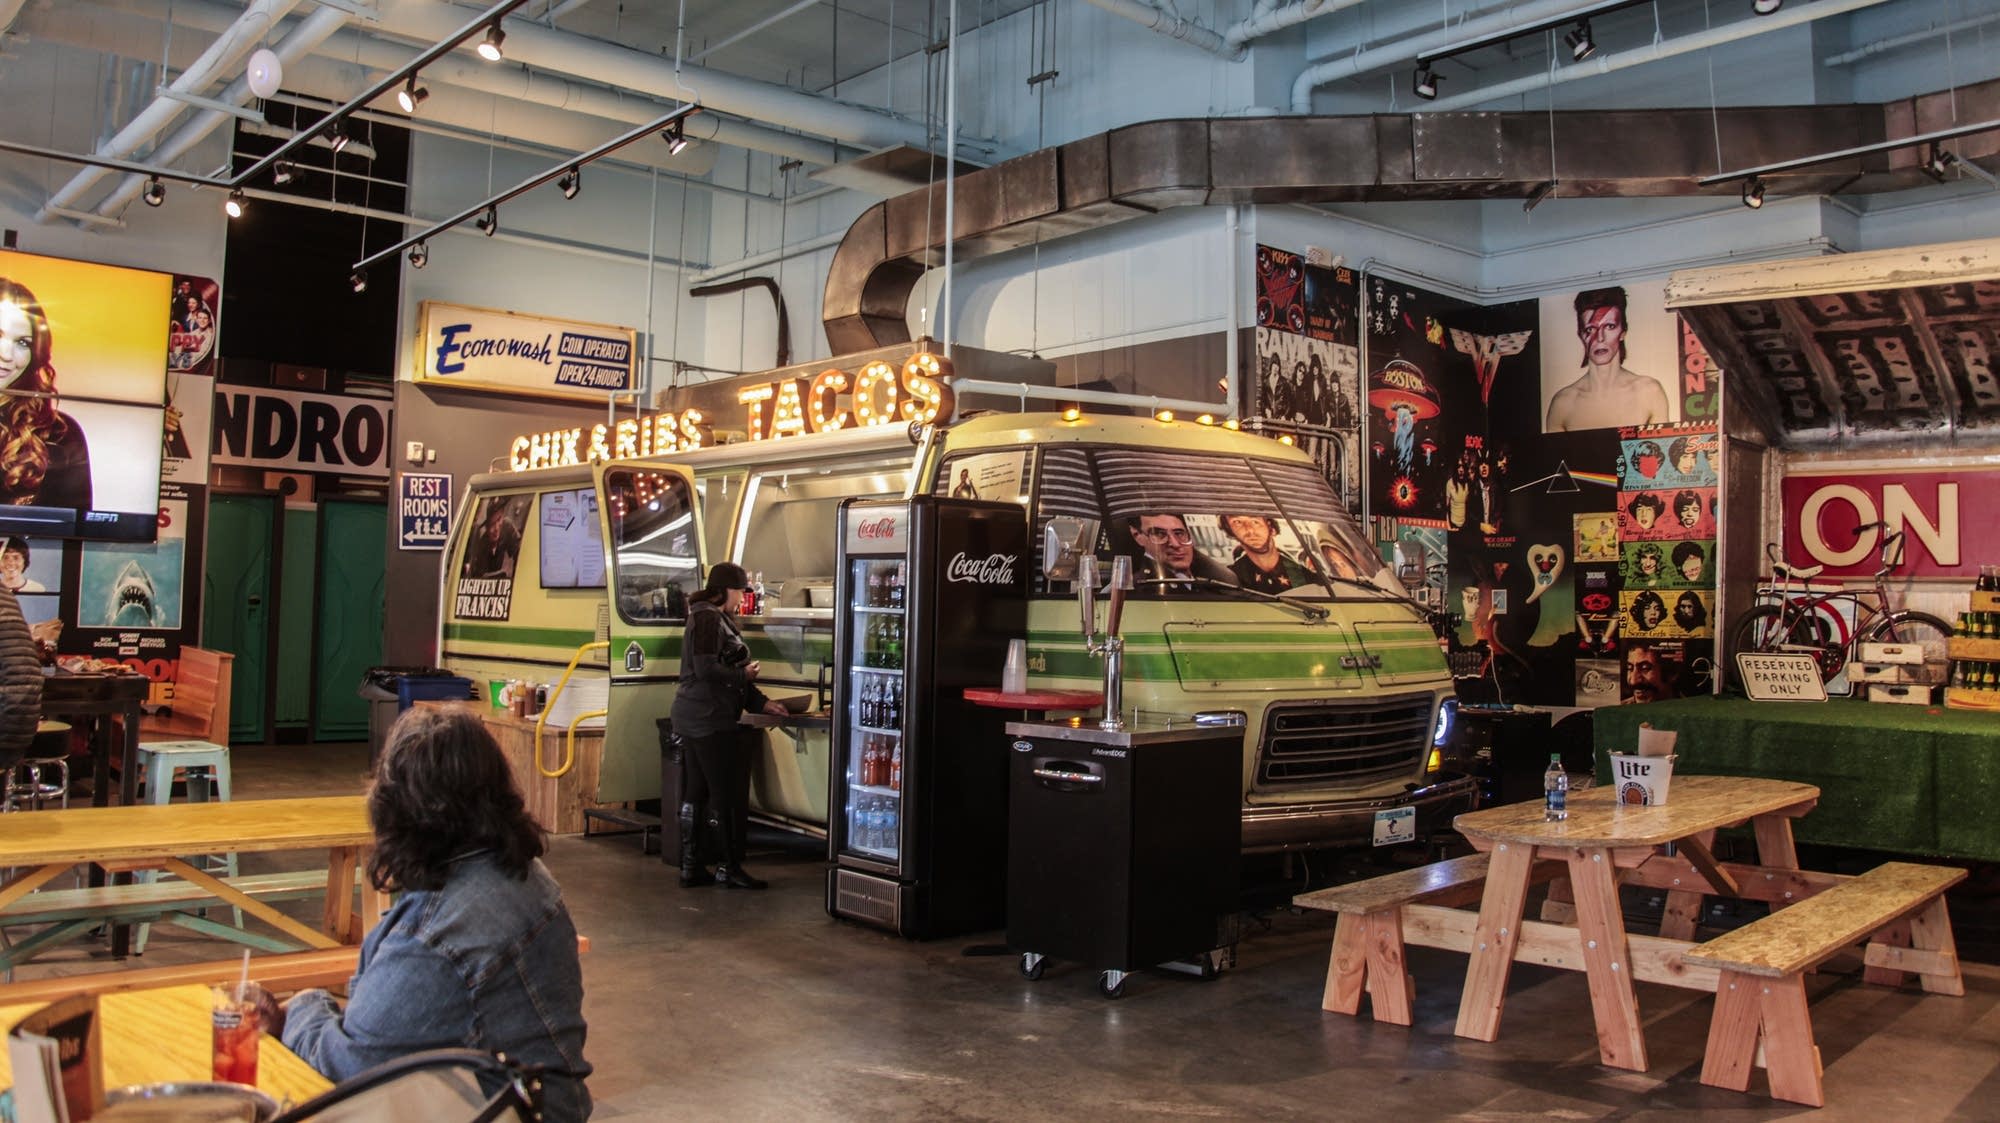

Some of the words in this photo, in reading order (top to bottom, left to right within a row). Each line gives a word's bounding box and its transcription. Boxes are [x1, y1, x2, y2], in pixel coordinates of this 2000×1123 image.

[561, 336, 584, 355] COIN
[583, 339, 628, 361] OPERATED
[559, 364, 585, 383] OPEN
[581, 365, 598, 386] 24
[594, 368, 626, 388] HOURS
[1385, 370, 1426, 391] BOSTON
[738, 352, 948, 442] TACOS
[212, 391, 393, 468] NDRO
[510, 428, 581, 472] CHIX
[587, 423, 611, 463] &
[615, 408, 703, 460] RIBS
[410, 478, 442, 497] REST
[85, 512, 119, 523] ESPN
[404, 499, 448, 518] ROOMS
[858, 517, 896, 539] Coca-Cola
[1800, 483, 1961, 567] ON
[947, 552, 1018, 584] Coca-Cola
[459, 579, 498, 595] LIGHTEN
[456, 595, 509, 618] FRANCIS!
[1744, 660, 1812, 671] RESERVED
[1754, 672, 1810, 683] PARKING
[1769, 684, 1801, 694] ONLY
[1620, 761, 1650, 779] Lite
